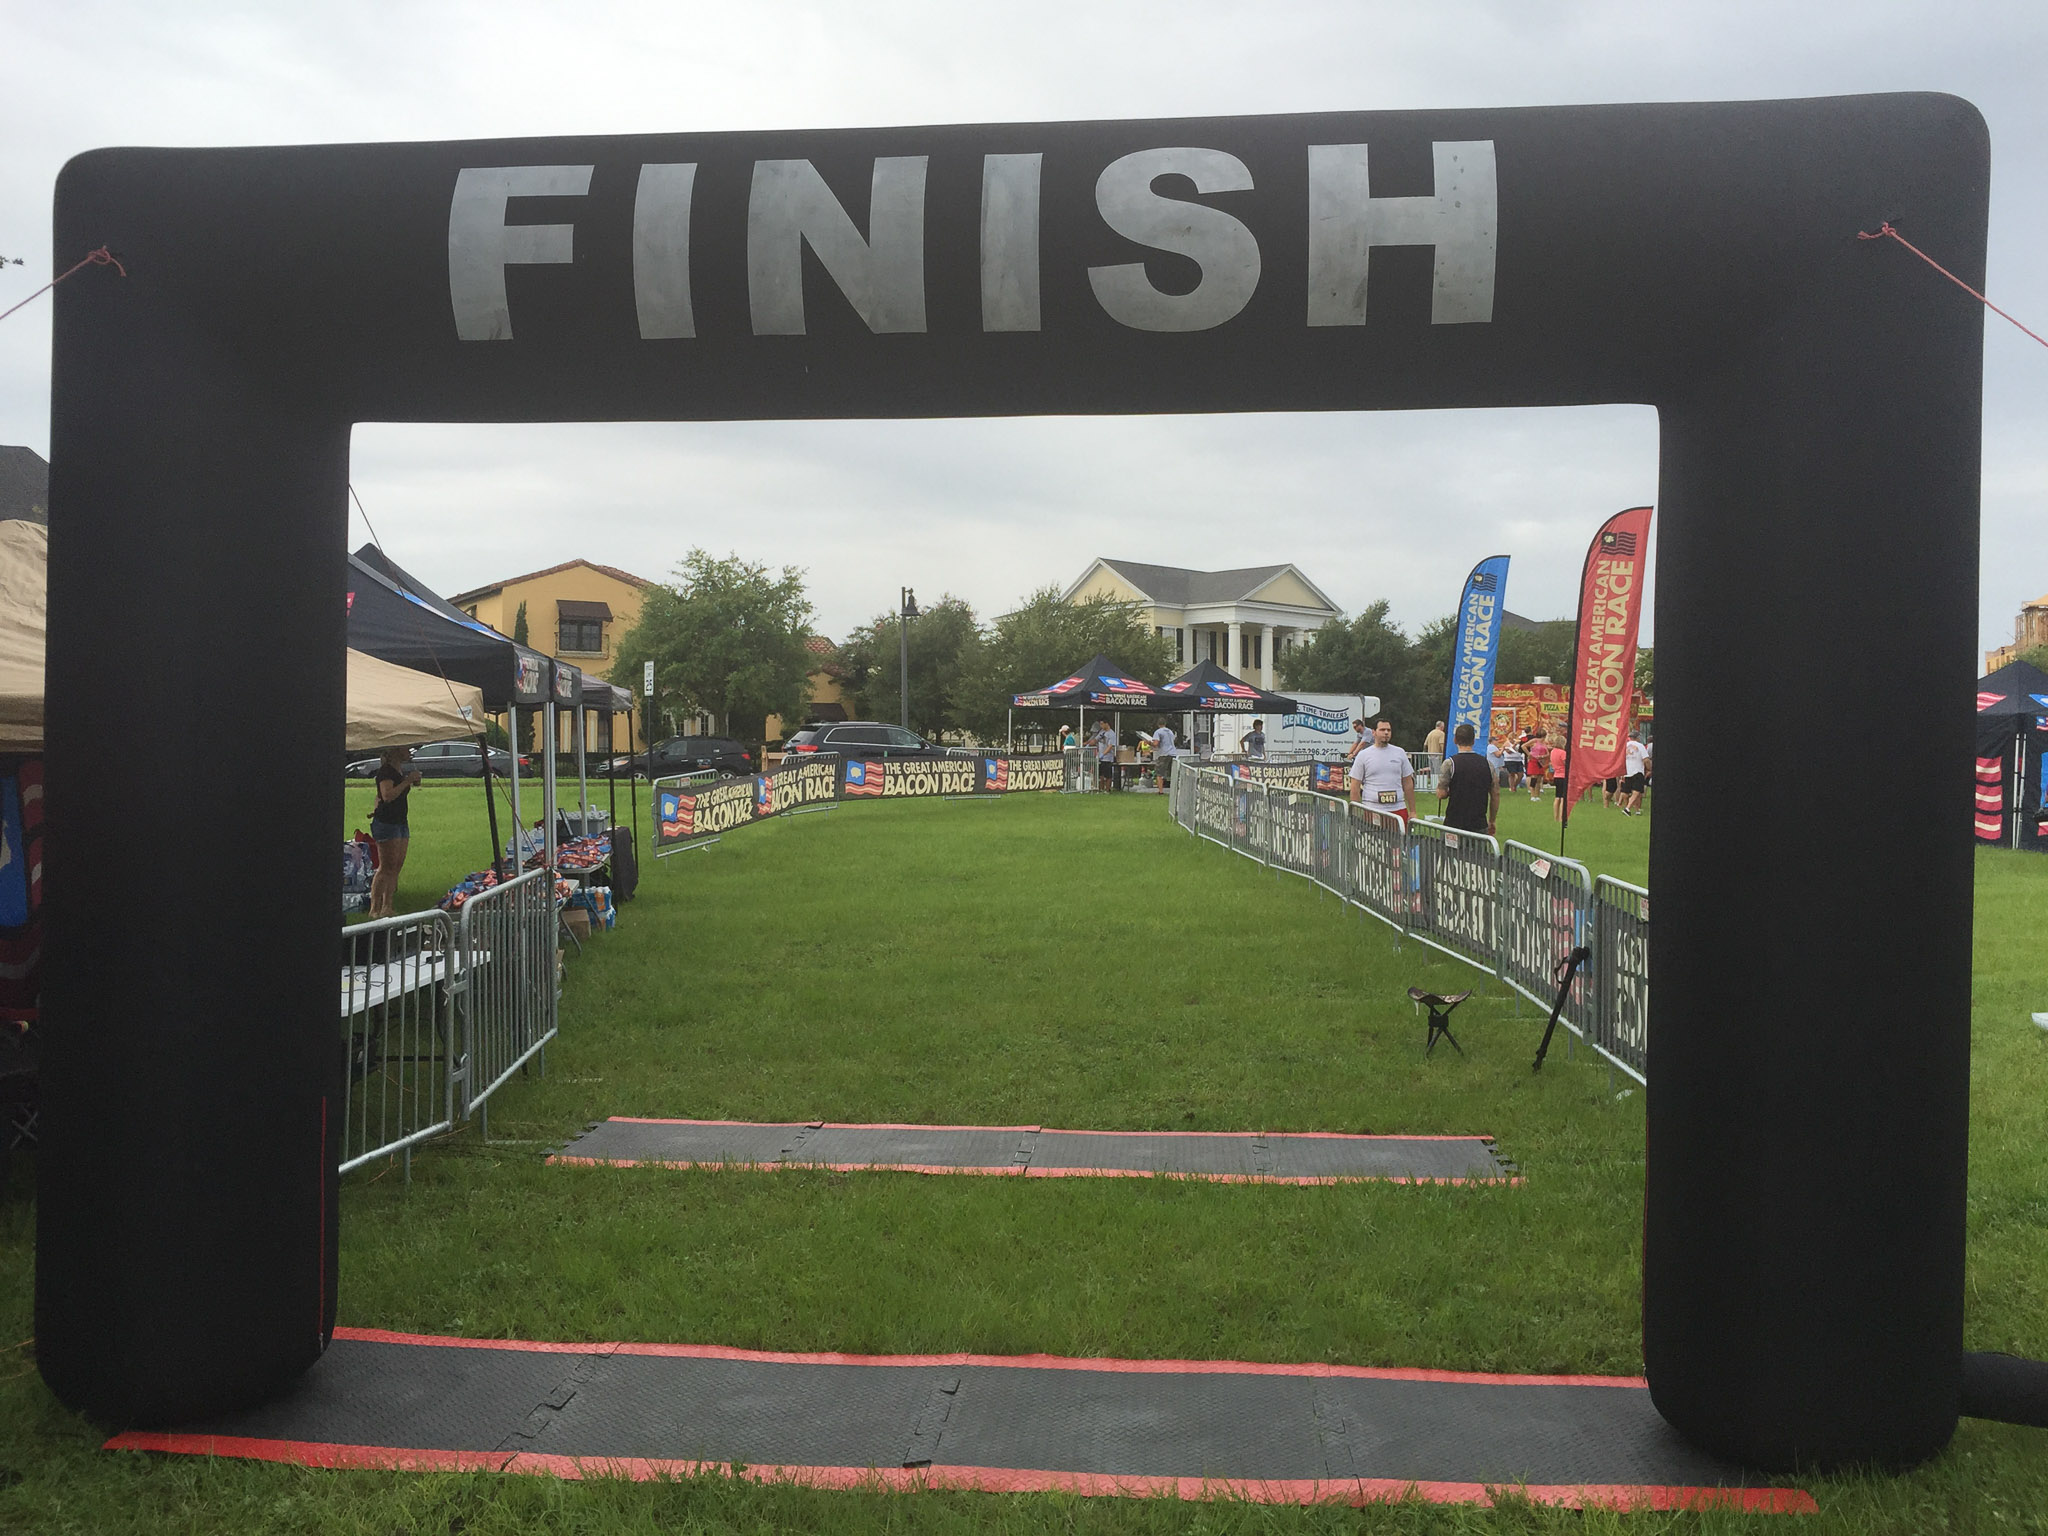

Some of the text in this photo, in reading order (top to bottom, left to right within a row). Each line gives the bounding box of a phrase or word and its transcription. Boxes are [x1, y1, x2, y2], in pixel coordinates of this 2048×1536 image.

[448, 139, 1498, 342] FINISH
[1463, 593, 1480, 665] AMERICAN
[1472, 595, 1495, 652] RACE
[1579, 560, 1611, 748] THE GREAT AMERICAN
[1594, 560, 1634, 752] BACON RACE
[1457, 667, 1471, 709] GREAT
[1105, 697, 1147, 706] BACON RACE
[1214, 701, 1254, 710] BACON RACE
[1302, 705, 1317, 714] TIME
[1319, 710, 1348, 719] TRAILERS
[798, 763, 836, 781] AMERICAN
[884, 760, 975, 775] THE GREAT AMERICAN
[1008, 758, 1064, 771] THE GREAT AMERICAN
[1249, 765, 1310, 778] THE GREAT AMERICAN
[806, 776, 835, 801] RACE
[882, 773, 976, 796] BACON RACE
[1007, 769, 1064, 790] BACON RACE
[695, 791, 711, 809] THE
[693, 800, 734, 833] BACON
